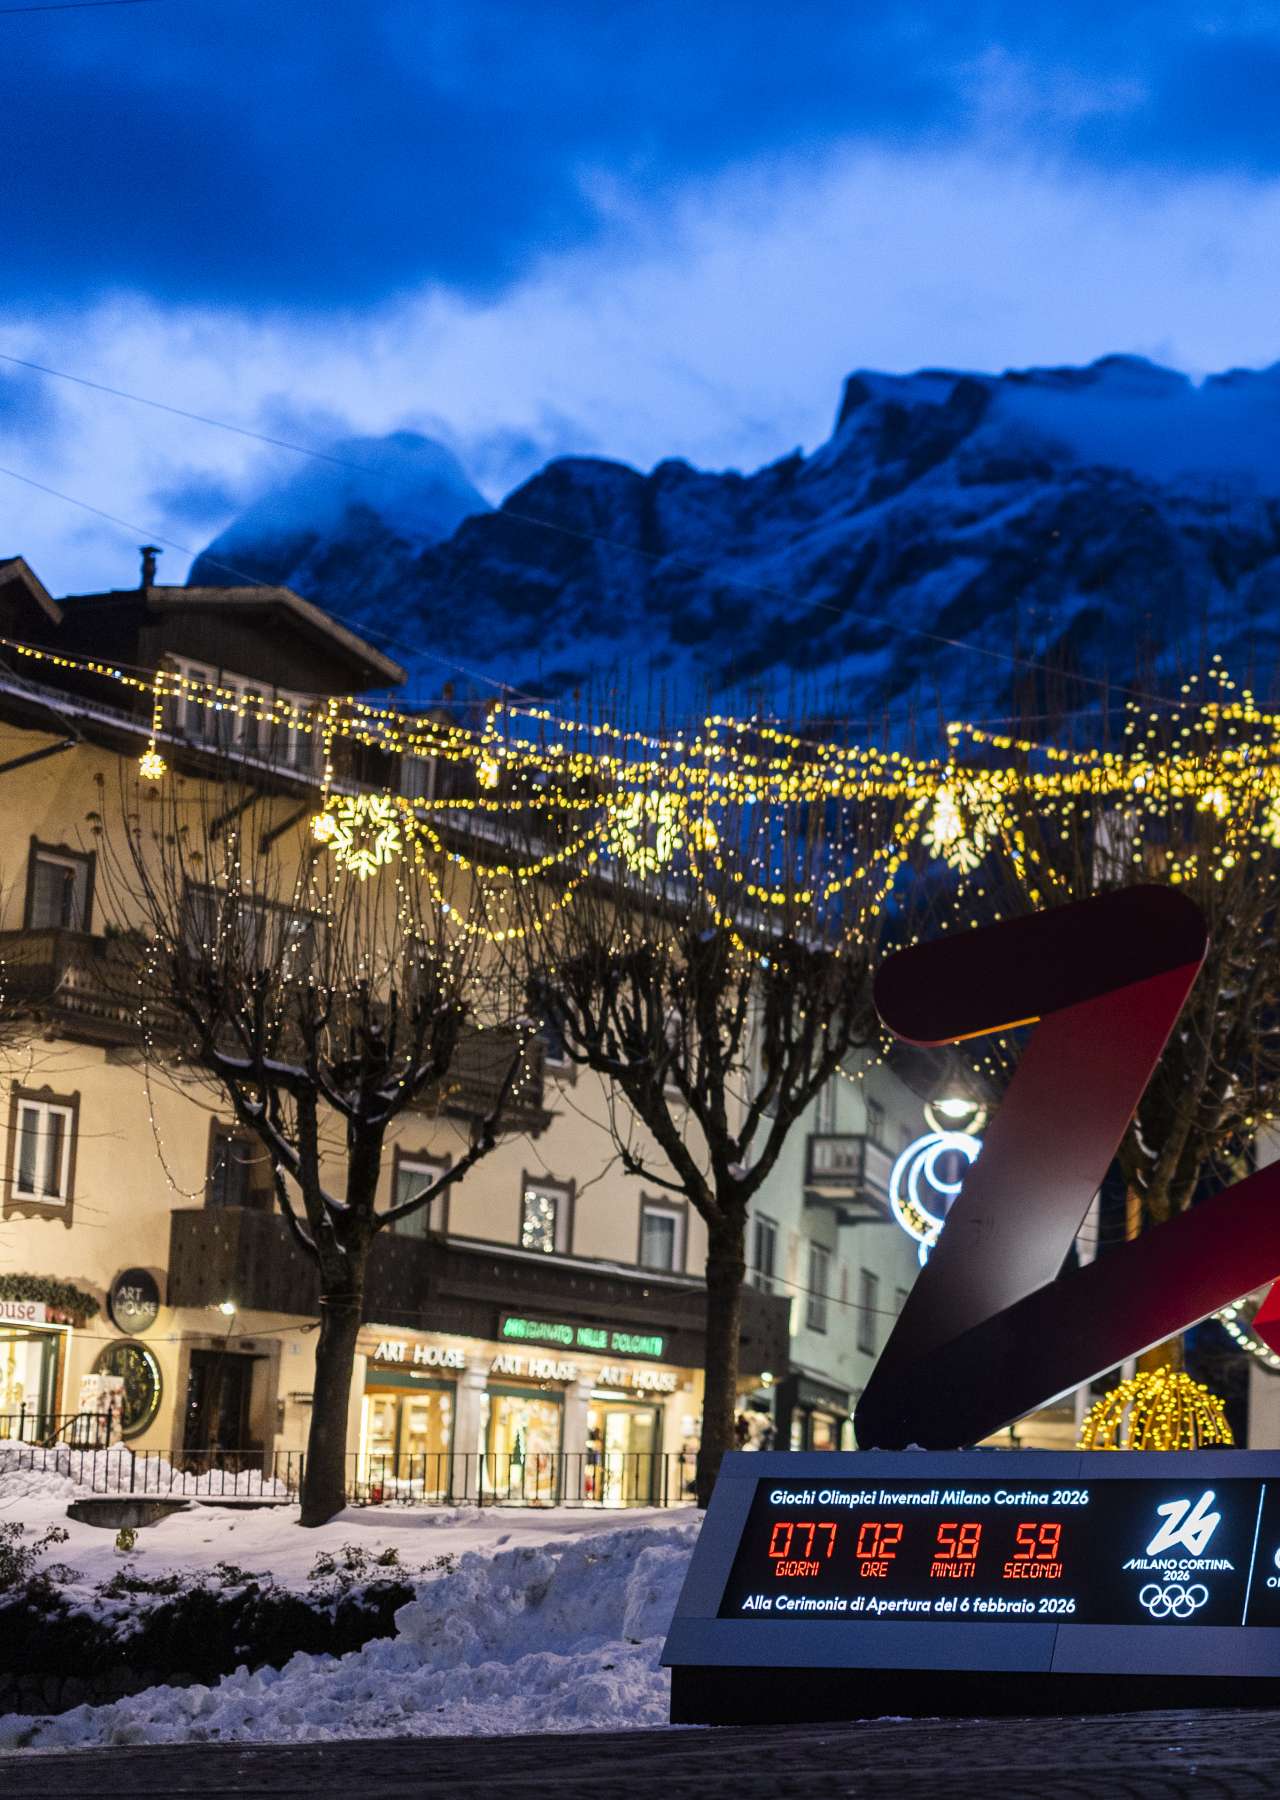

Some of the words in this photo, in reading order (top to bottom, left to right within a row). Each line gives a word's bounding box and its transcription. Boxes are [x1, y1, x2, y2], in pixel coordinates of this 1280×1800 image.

[117, 1286, 144, 1300] ART
[115, 1300, 157, 1317] HOUSE
[375, 1342, 408, 1362] ART
[413, 1345, 465, 1369] HOUSE
[492, 1354, 522, 1375] ART
[528, 1358, 578, 1381] HOUSE
[596, 1365, 627, 1386] ART
[632, 1368, 678, 1392] HOUSE
[769, 1489, 816, 1506] Giochi
[819, 1489, 876, 1509] Olimpici
[878, 1489, 939, 1506] Invernali
[940, 1490, 991, 1506] Milano
[993, 1490, 1049, 1506] Cortina
[1051, 1490, 1090, 1506] 2026
[768, 1522, 838, 1559] 077
[855, 1522, 904, 1559] 02
[933, 1522, 983, 1559] 58
[1013, 1522, 1062, 1560] 59
[775, 1560, 820, 1577] GIORNI
[860, 1561, 889, 1578] ORE
[929, 1561, 976, 1579] MINUTI
[1002, 1562, 1063, 1579] SECONDI
[1122, 1558, 1178, 1571] MILANO
[1178, 1558, 1236, 1571] CORTINA
[1162, 1570, 1191, 1582] 2026
[742, 1595, 773, 1611] Alla
[775, 1596, 849, 1612] Cerimonia
[850, 1596, 866, 1611] di
[866, 1596, 932, 1616] Apertura
[935, 1597, 958, 1612] del
[960, 1597, 970, 1613] 6
[973, 1598, 1036, 1613] febbraio
[1038, 1598, 1077, 1614] 2026
